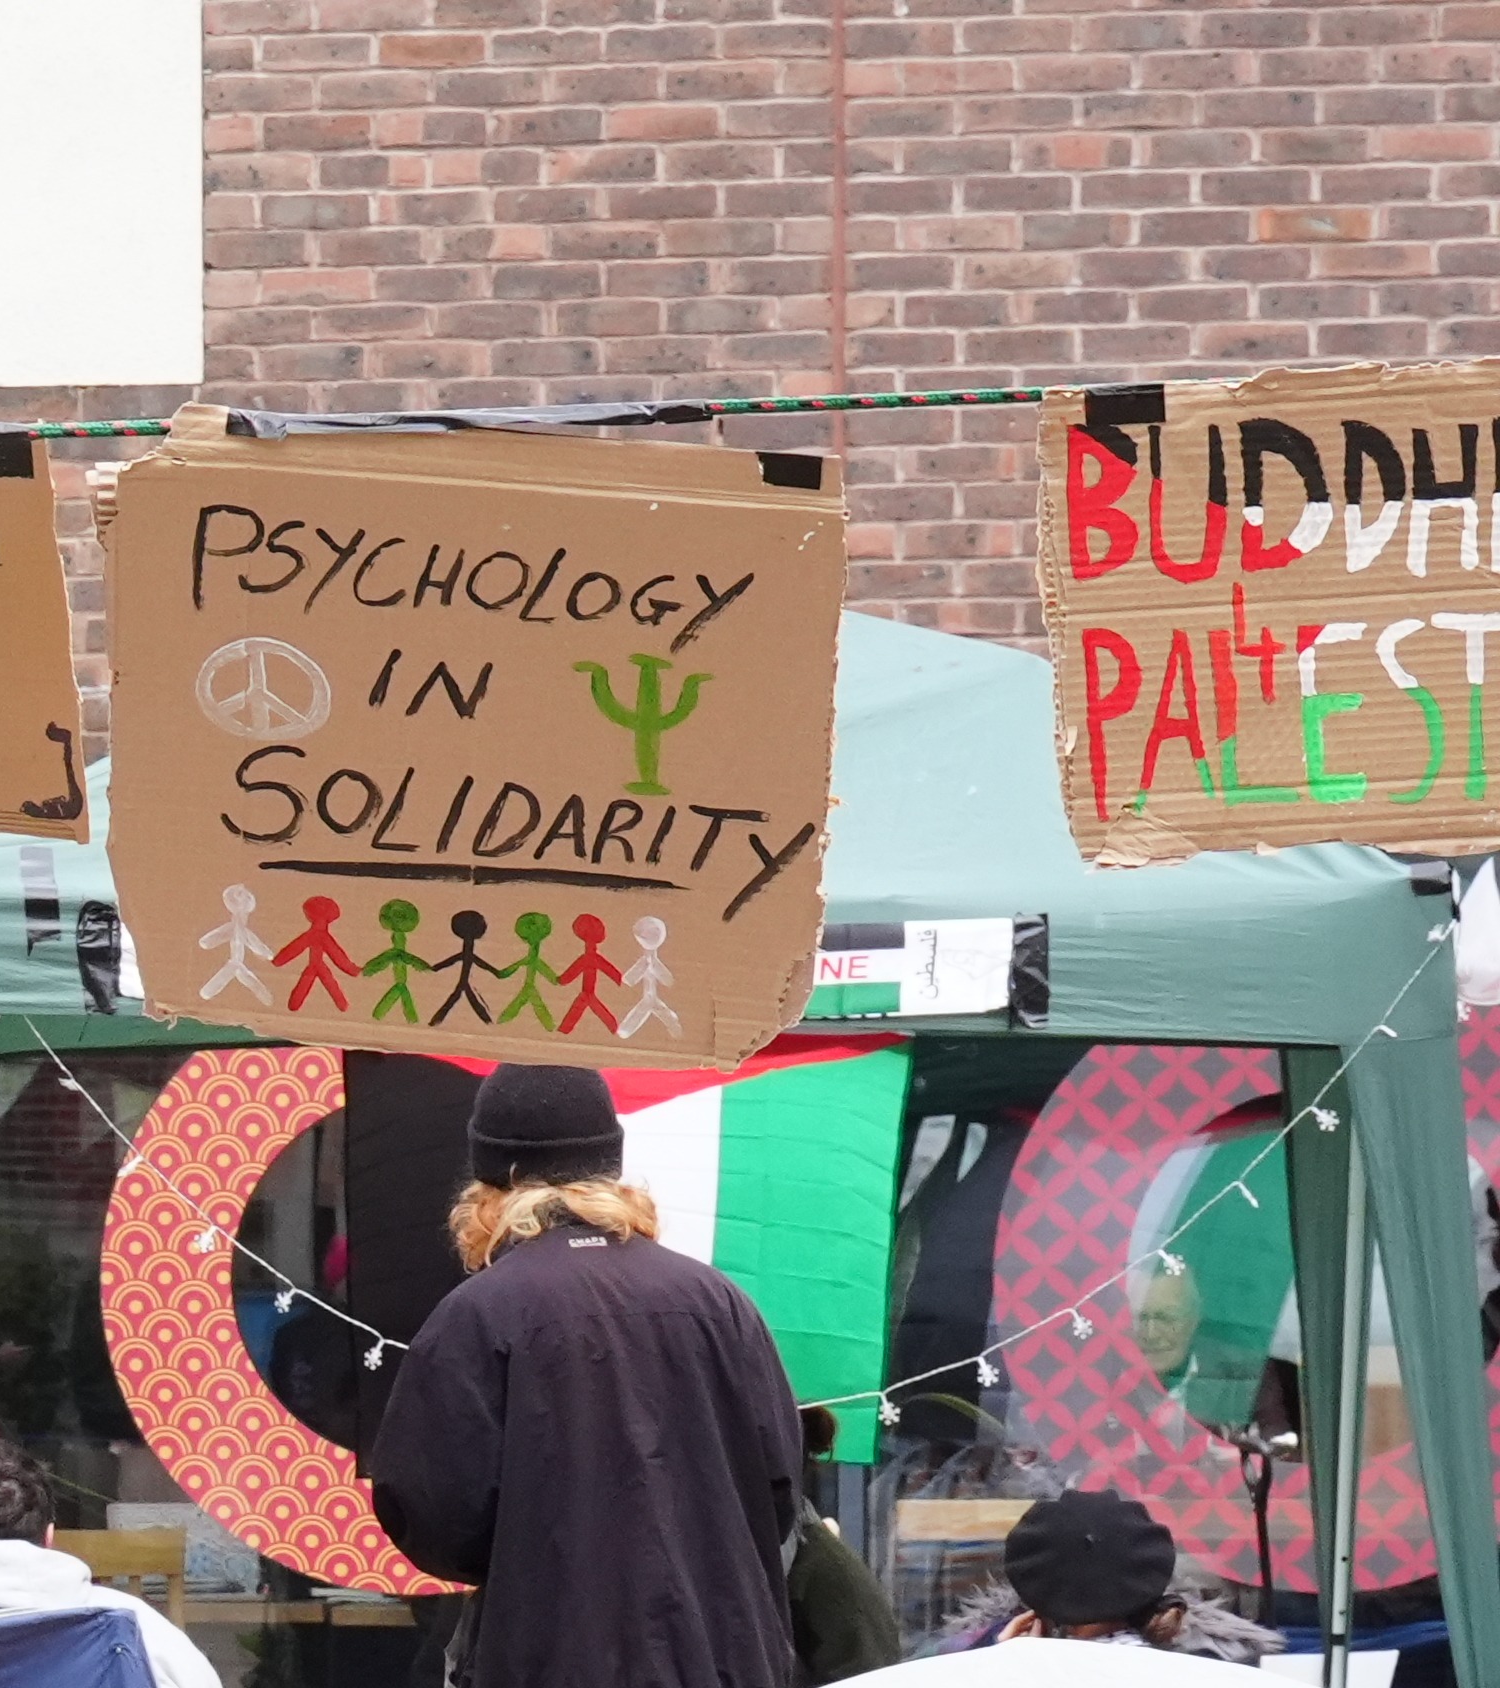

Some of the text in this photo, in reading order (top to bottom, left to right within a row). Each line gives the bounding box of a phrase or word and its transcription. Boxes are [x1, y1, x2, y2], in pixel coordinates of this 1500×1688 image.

[192, 504, 755, 655] PSYCHOLOGY
[368, 648, 494, 720] IN
[220, 744, 817, 923] SOLIDARITY
